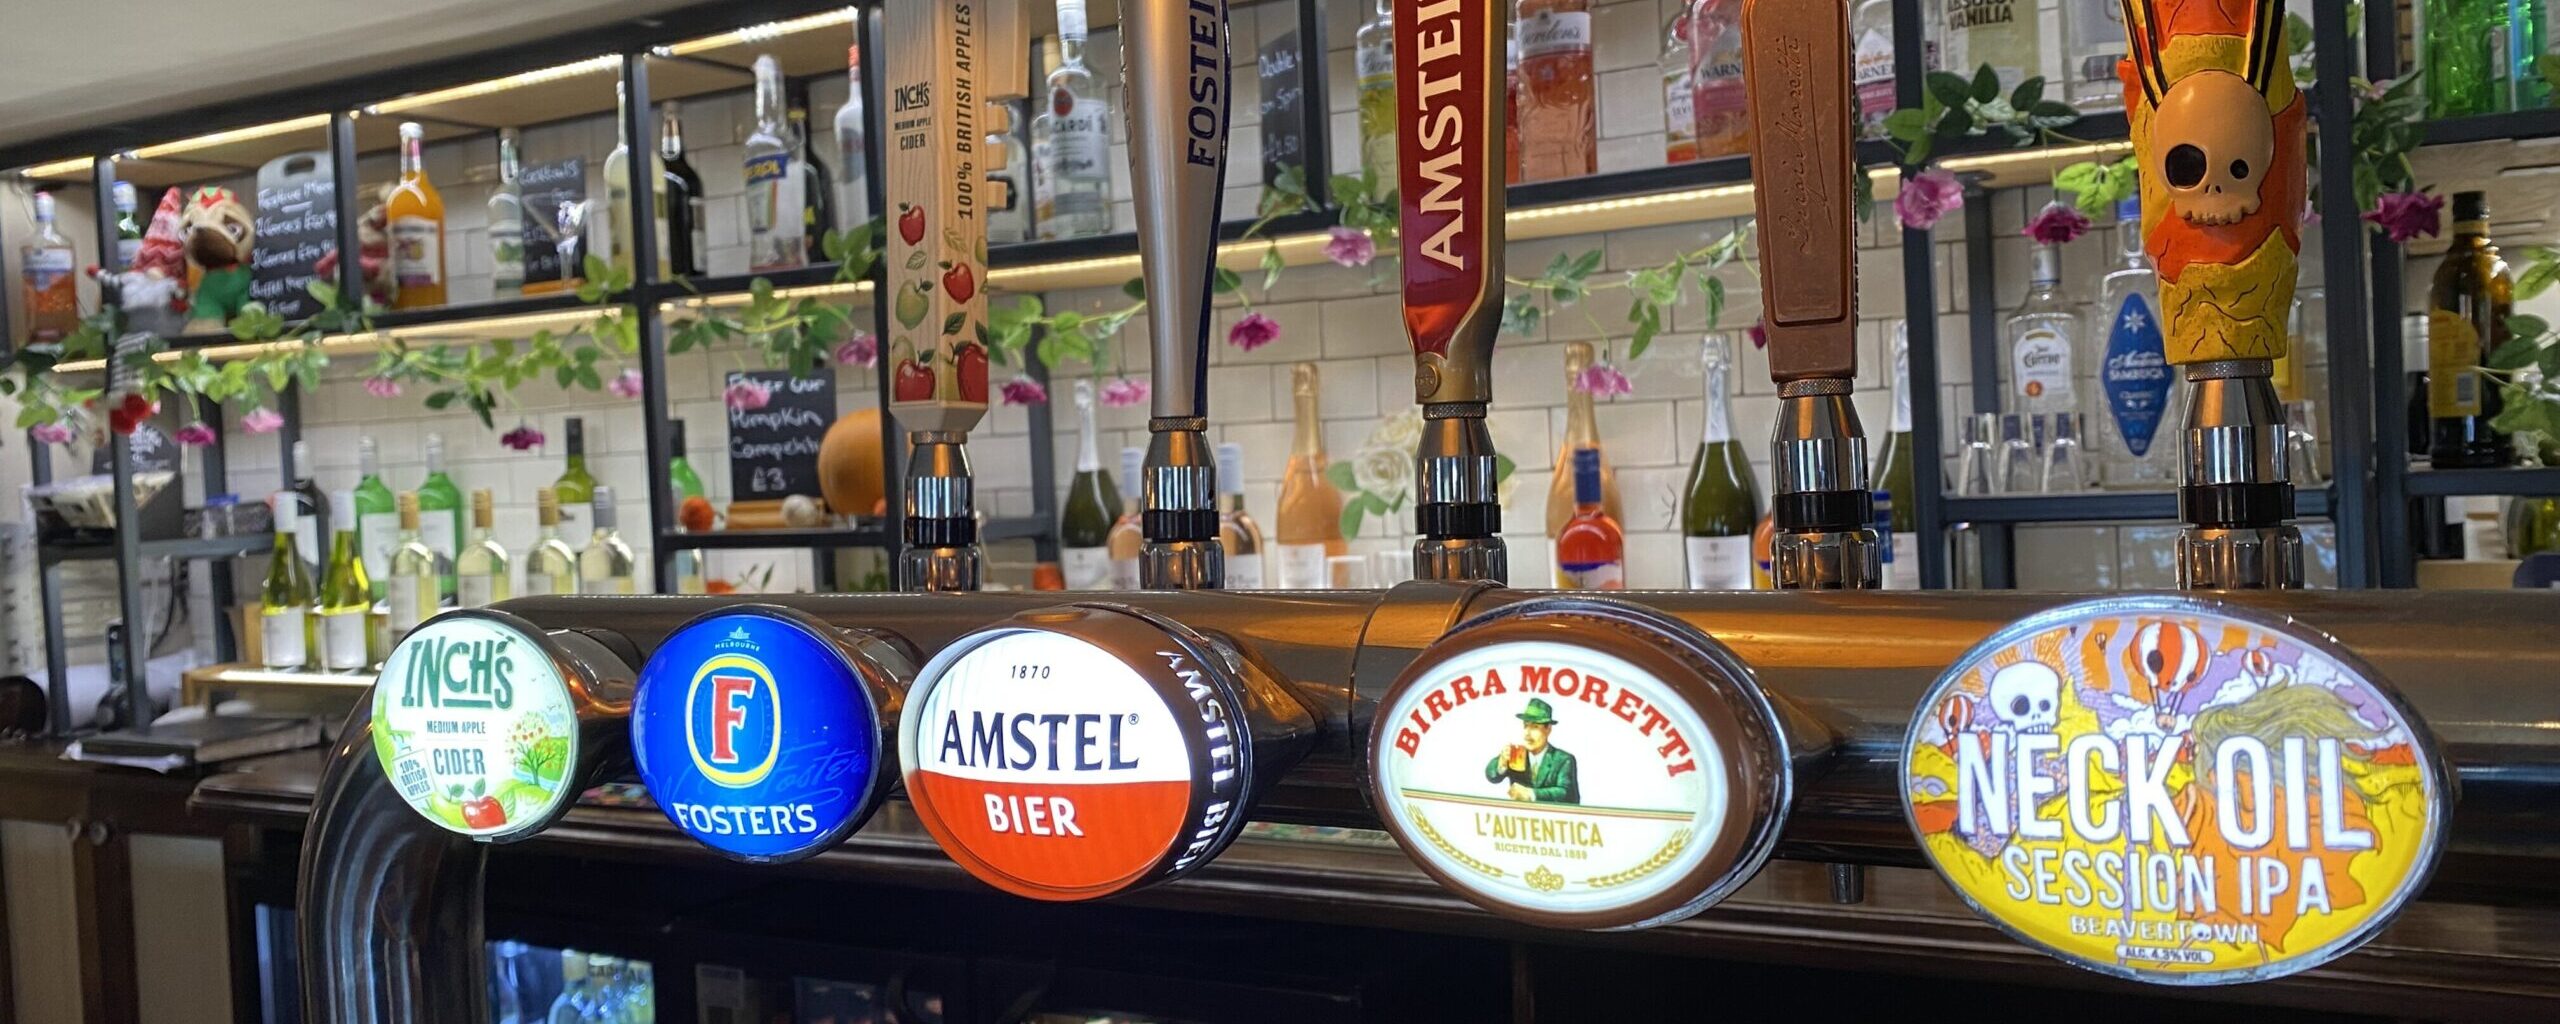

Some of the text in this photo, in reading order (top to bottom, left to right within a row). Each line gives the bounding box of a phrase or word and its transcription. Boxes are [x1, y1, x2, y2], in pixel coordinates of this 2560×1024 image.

[916, 116, 932, 127] APPLE
[955, 4, 974, 220] 100% BRITISH APPLES
[900, 133, 926, 150] CIDER
[714, 641, 761, 652] MELBOURNE
[1010, 664, 1051, 680] 1870
[426, 720, 487, 735] MEDIUM APPLE
[711, 674, 756, 764] F
[1394, 665, 1697, 778] BIRRA MORETTI
[399, 758, 421, 775] 100%
[433, 748, 487, 777] CIDER
[400, 767, 428, 787] BRITISH
[407, 780, 431, 797] APPLES
[1957, 732, 2376, 852] NECK OIL
[672, 802, 817, 836] FOSTER'S
[983, 793, 1084, 837] BIER
[1474, 812, 1605, 849] L'AUTENTICA
[1494, 842, 1540, 857] RICETTA
[1541, 846, 1563, 858] DAL
[2002, 844, 2334, 917] SESSION IPA
[2150, 950, 2181, 962] 4.3%
[2184, 952, 2206, 963] VOL
